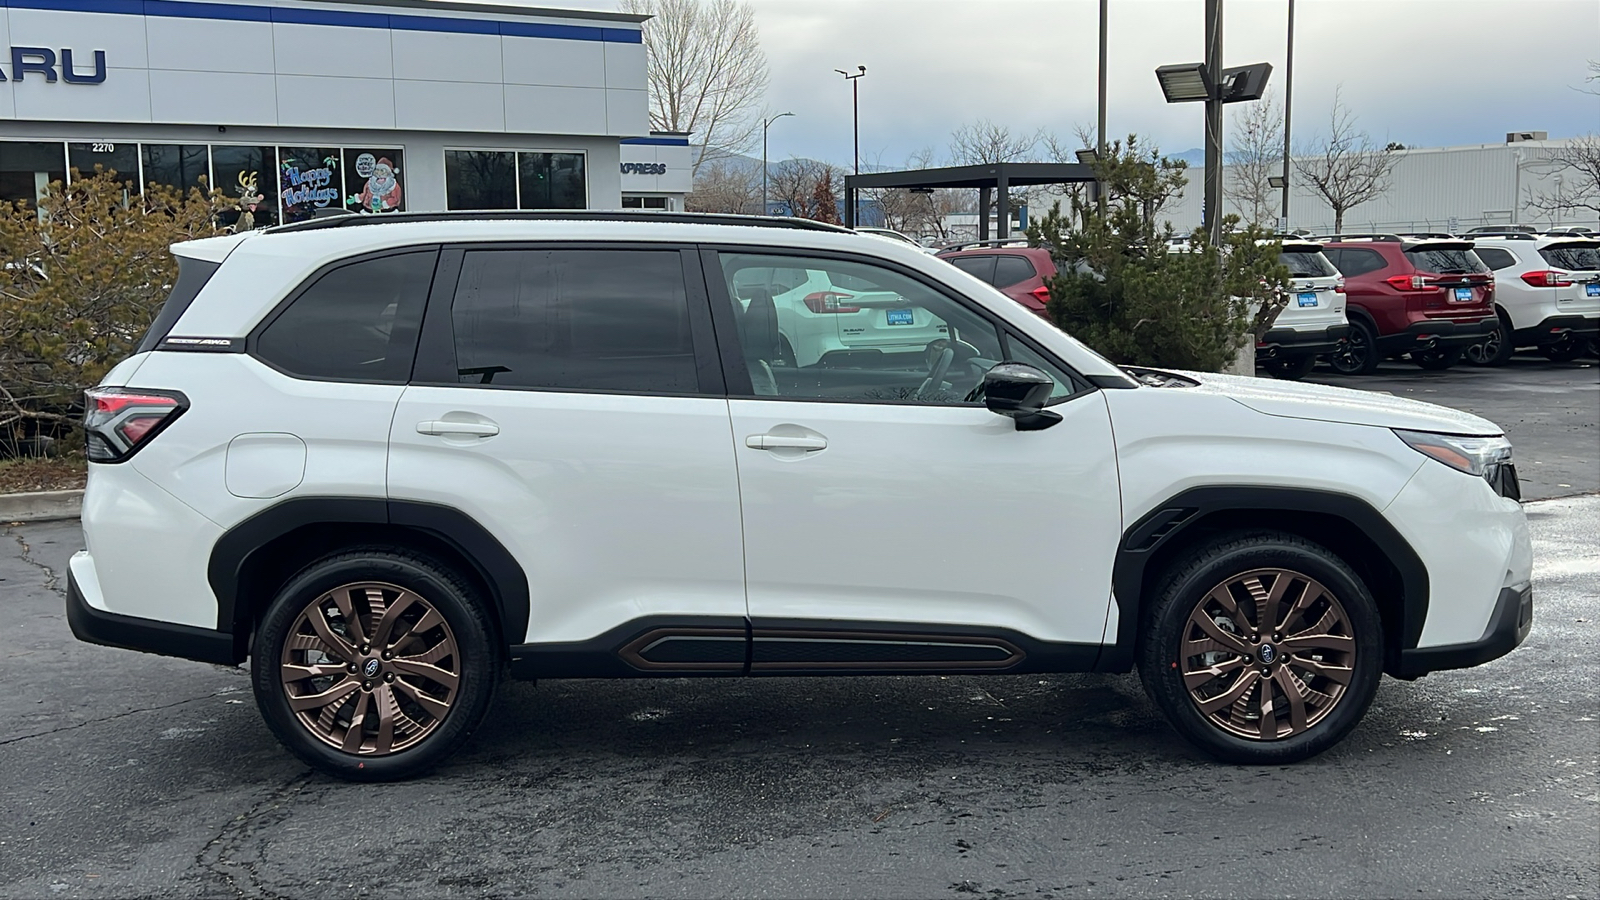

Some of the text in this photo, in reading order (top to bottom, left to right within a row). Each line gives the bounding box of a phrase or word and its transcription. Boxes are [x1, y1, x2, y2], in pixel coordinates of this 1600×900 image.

[0, 46, 106, 85] RU
[92, 143, 114, 152] 2270
[286, 166, 332, 187] Happy
[282, 184, 338, 207] Holidays
